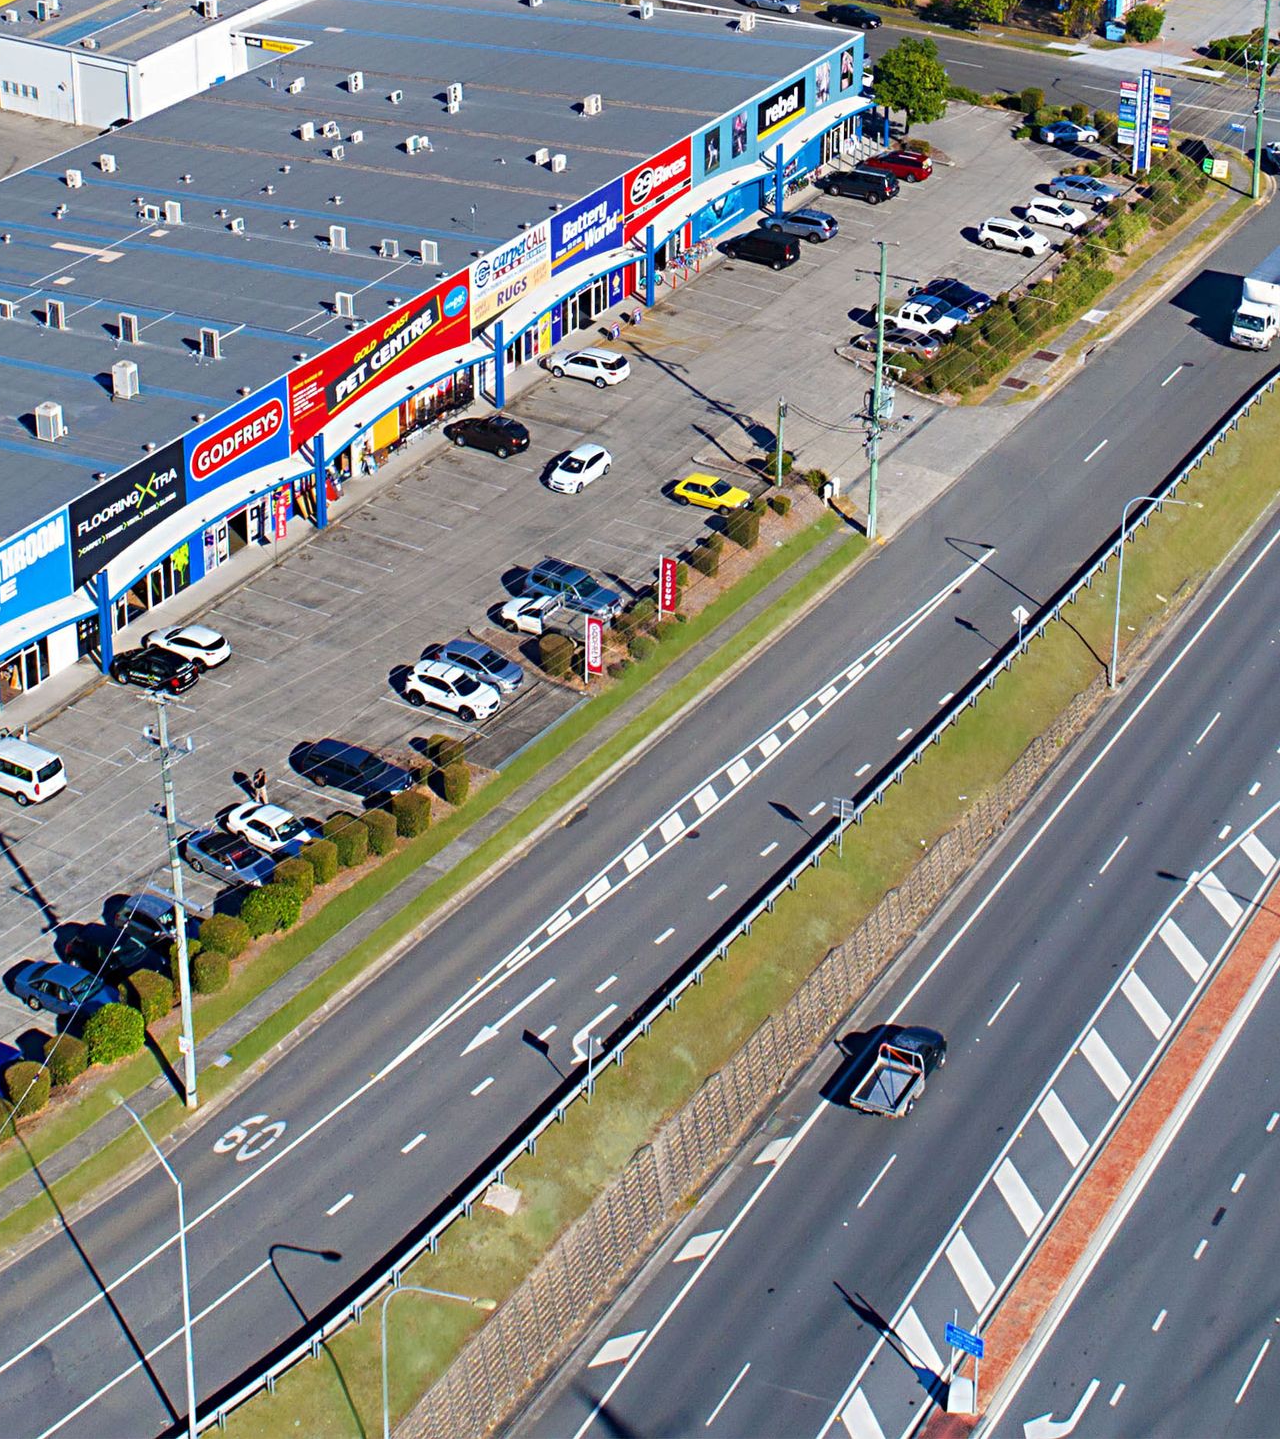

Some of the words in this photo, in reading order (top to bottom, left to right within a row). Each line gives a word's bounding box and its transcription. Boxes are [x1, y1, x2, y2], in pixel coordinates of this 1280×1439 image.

[765, 86, 799, 127] rebel
[562, 201, 608, 245] Battery
[584, 212, 618, 251] World
[497, 276, 528, 308] RUGS
[335, 363, 368, 403] PET
[370, 309, 433, 371] CENTRE
[353, 339, 378, 365] GOLD
[383, 311, 411, 340] COAST
[196, 409, 280, 472] GODFREYS
[212, 1113, 287, 1162] 60
